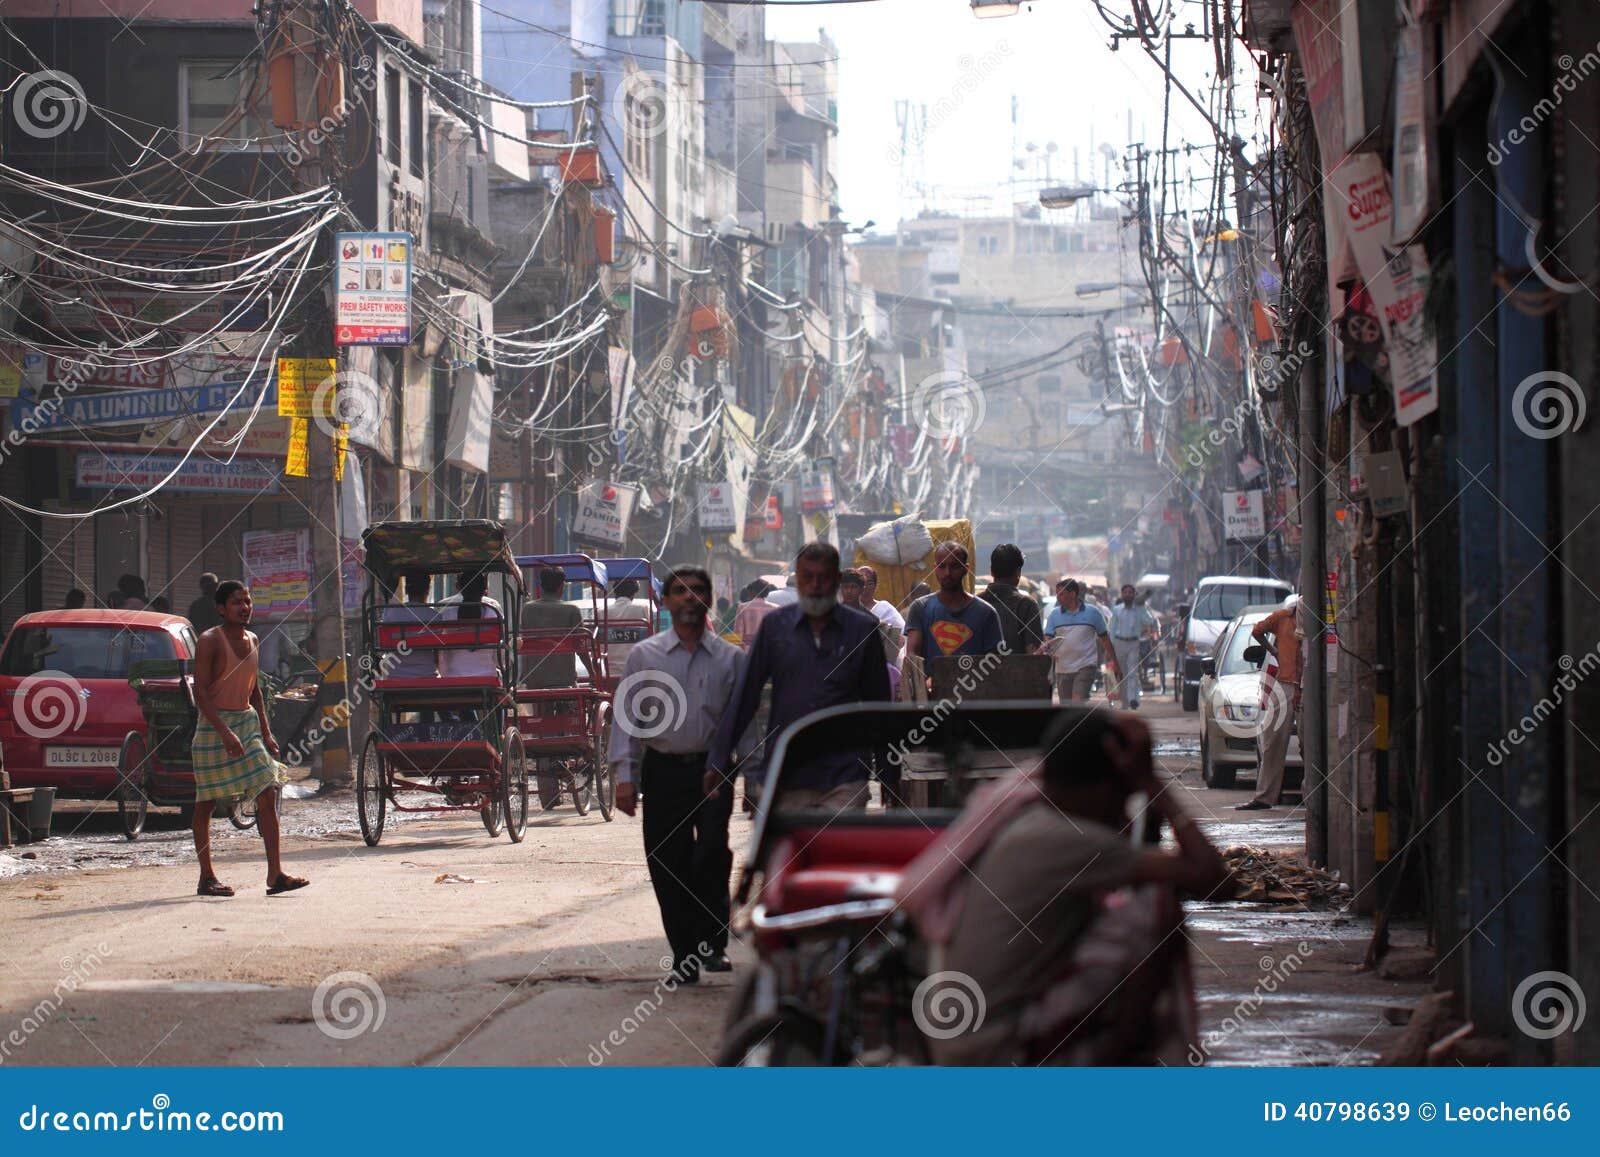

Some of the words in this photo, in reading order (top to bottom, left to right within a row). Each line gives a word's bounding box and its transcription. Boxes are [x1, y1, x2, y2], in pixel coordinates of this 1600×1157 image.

[340, 302, 357, 311] PREM
[359, 303, 383, 312] SAFETY
[384, 303, 408, 313] WORKS
[73, 390, 199, 421] ALUMINIUM
